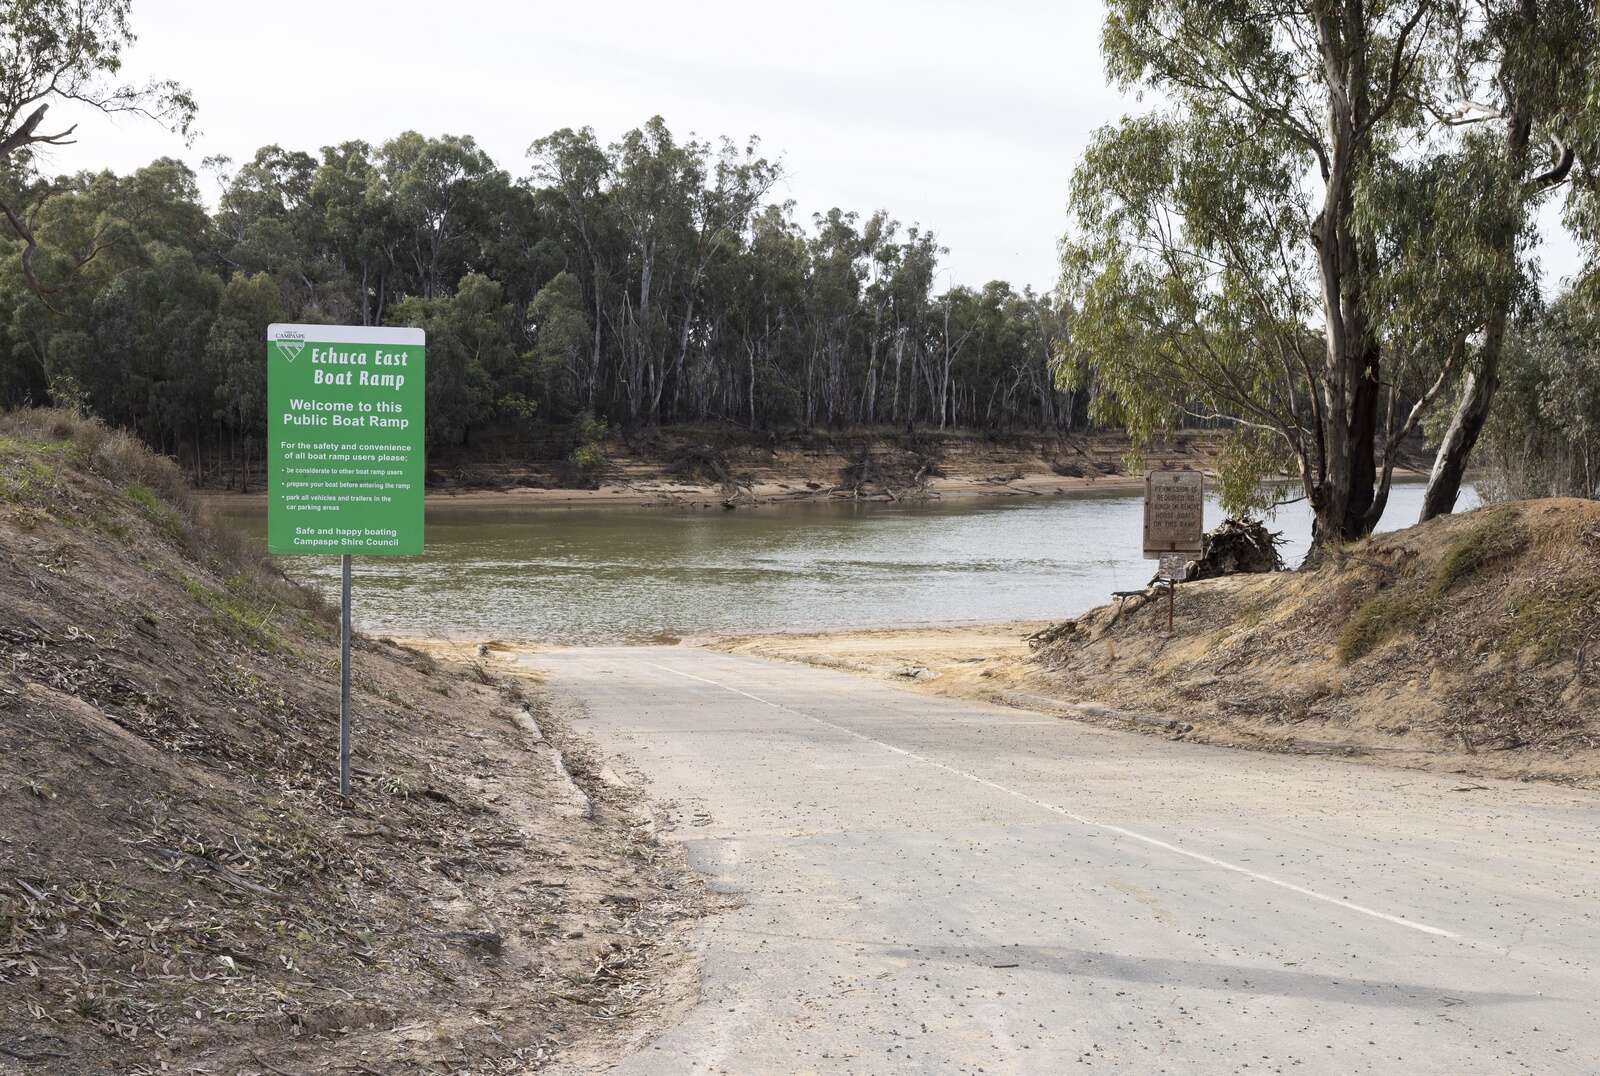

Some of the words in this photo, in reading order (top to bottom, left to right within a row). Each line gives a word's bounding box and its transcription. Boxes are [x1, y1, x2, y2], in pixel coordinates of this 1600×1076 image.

[312, 347, 367, 364] Echuca
[375, 350, 408, 366] East
[314, 369, 352, 385] Boat
[360, 371, 405, 390] Ramp
[290, 399, 354, 411] Welcome
[359, 401, 372, 412] to
[377, 402, 402, 412] this
[284, 414, 327, 425] Public
[333, 415, 365, 426] Boat
[370, 416, 409, 430] Ramp
[313, 443, 338, 451] safety
[336, 528, 361, 537] happy
[365, 529, 397, 537] boating
[294, 538, 338, 546] Campaspe
